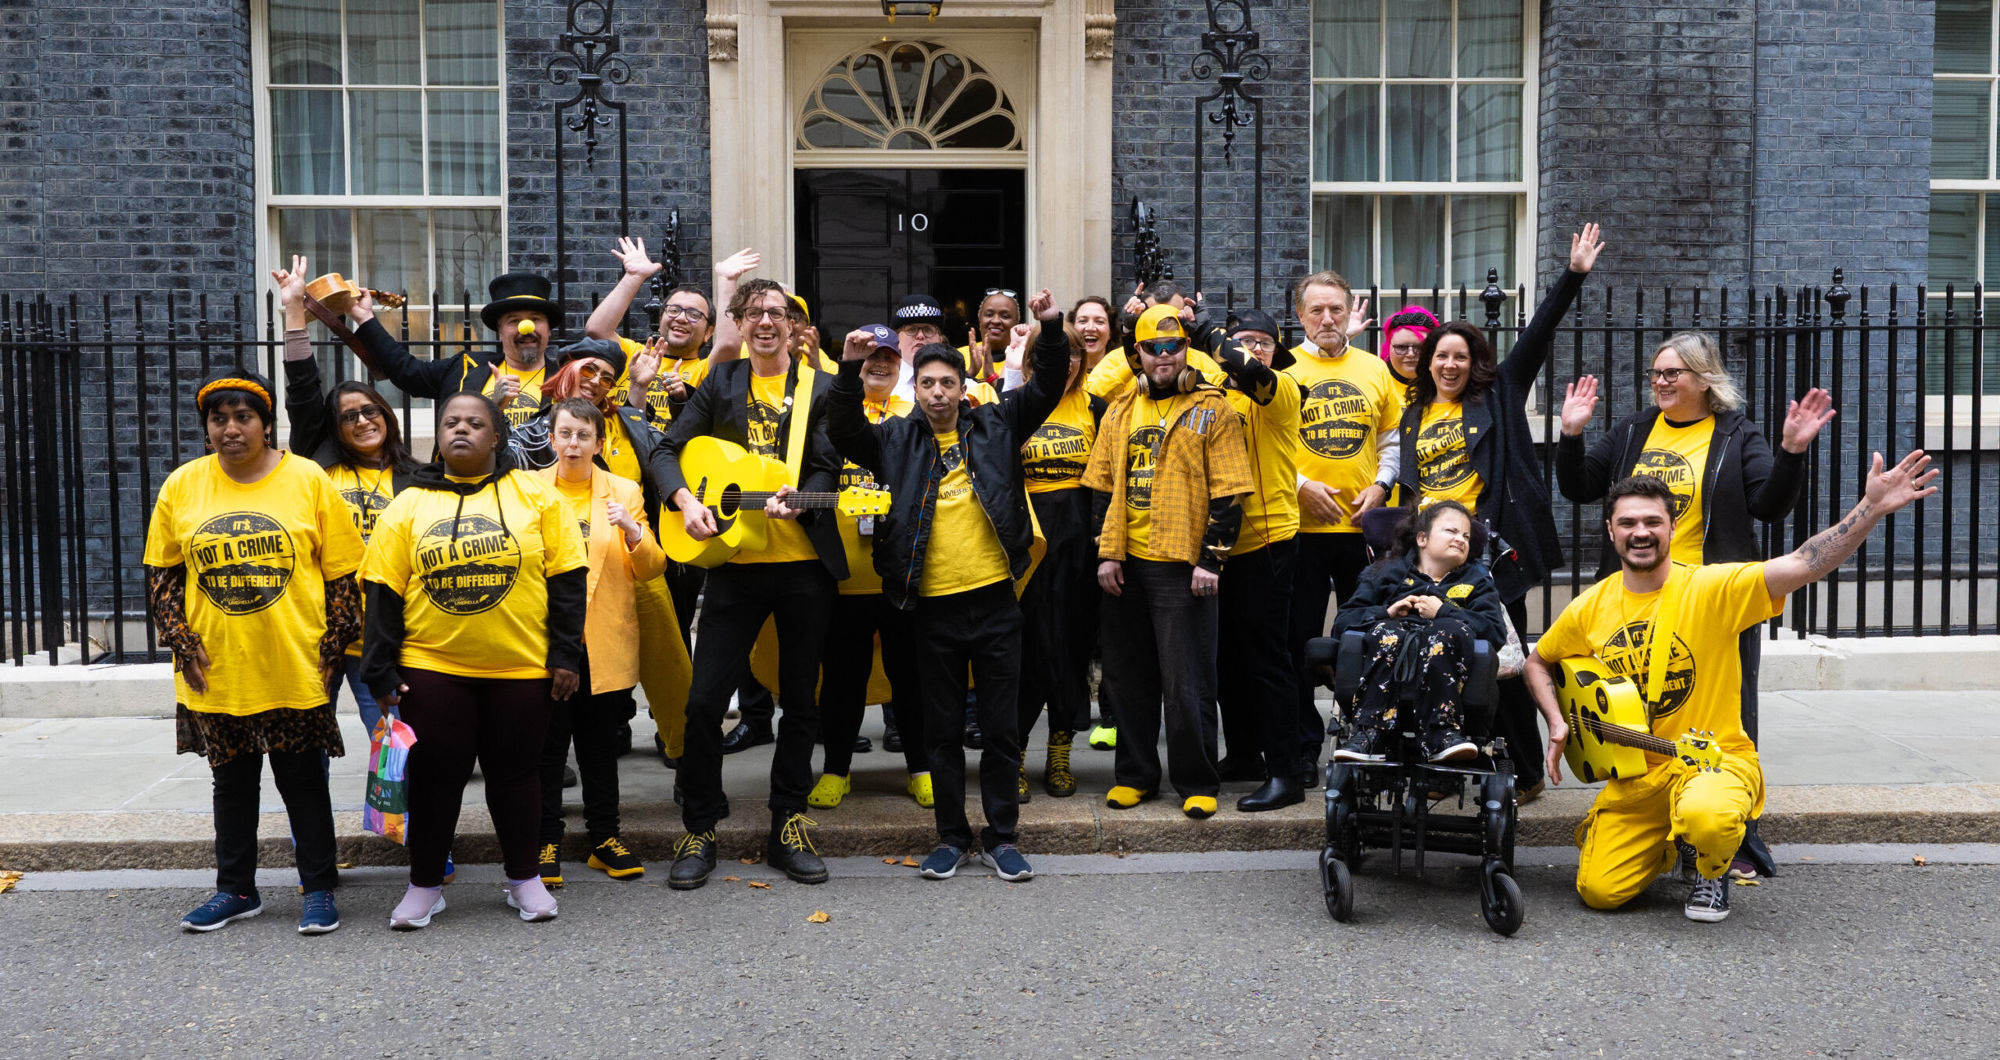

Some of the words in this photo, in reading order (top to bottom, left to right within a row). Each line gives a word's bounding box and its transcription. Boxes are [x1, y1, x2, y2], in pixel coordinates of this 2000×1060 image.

[898, 213, 929, 232] 10
[1300, 406, 1321, 424] NOT
[1324, 404, 1332, 418] A
[1333, 399, 1367, 416] CRIME
[1306, 430, 1316, 440] TO
[1318, 429, 1328, 438] BE
[1329, 428, 1364, 439] DIFFERENT
[1025, 444, 1038, 460] OT
[1042, 443, 1051, 457] A
[1052, 438, 1087, 456] CRIME
[195, 544, 219, 567] NOT
[223, 542, 234, 561] A
[237, 534, 284, 559] CRIME
[420, 546, 444, 571] NOT
[448, 543, 460, 562] A
[462, 535, 509, 559] CRIME
[230, 574, 282, 588] DIFFERENT
[427, 577, 440, 590] TO
[441, 576, 455, 589] BE
[456, 573, 507, 589] DIFFERENT
